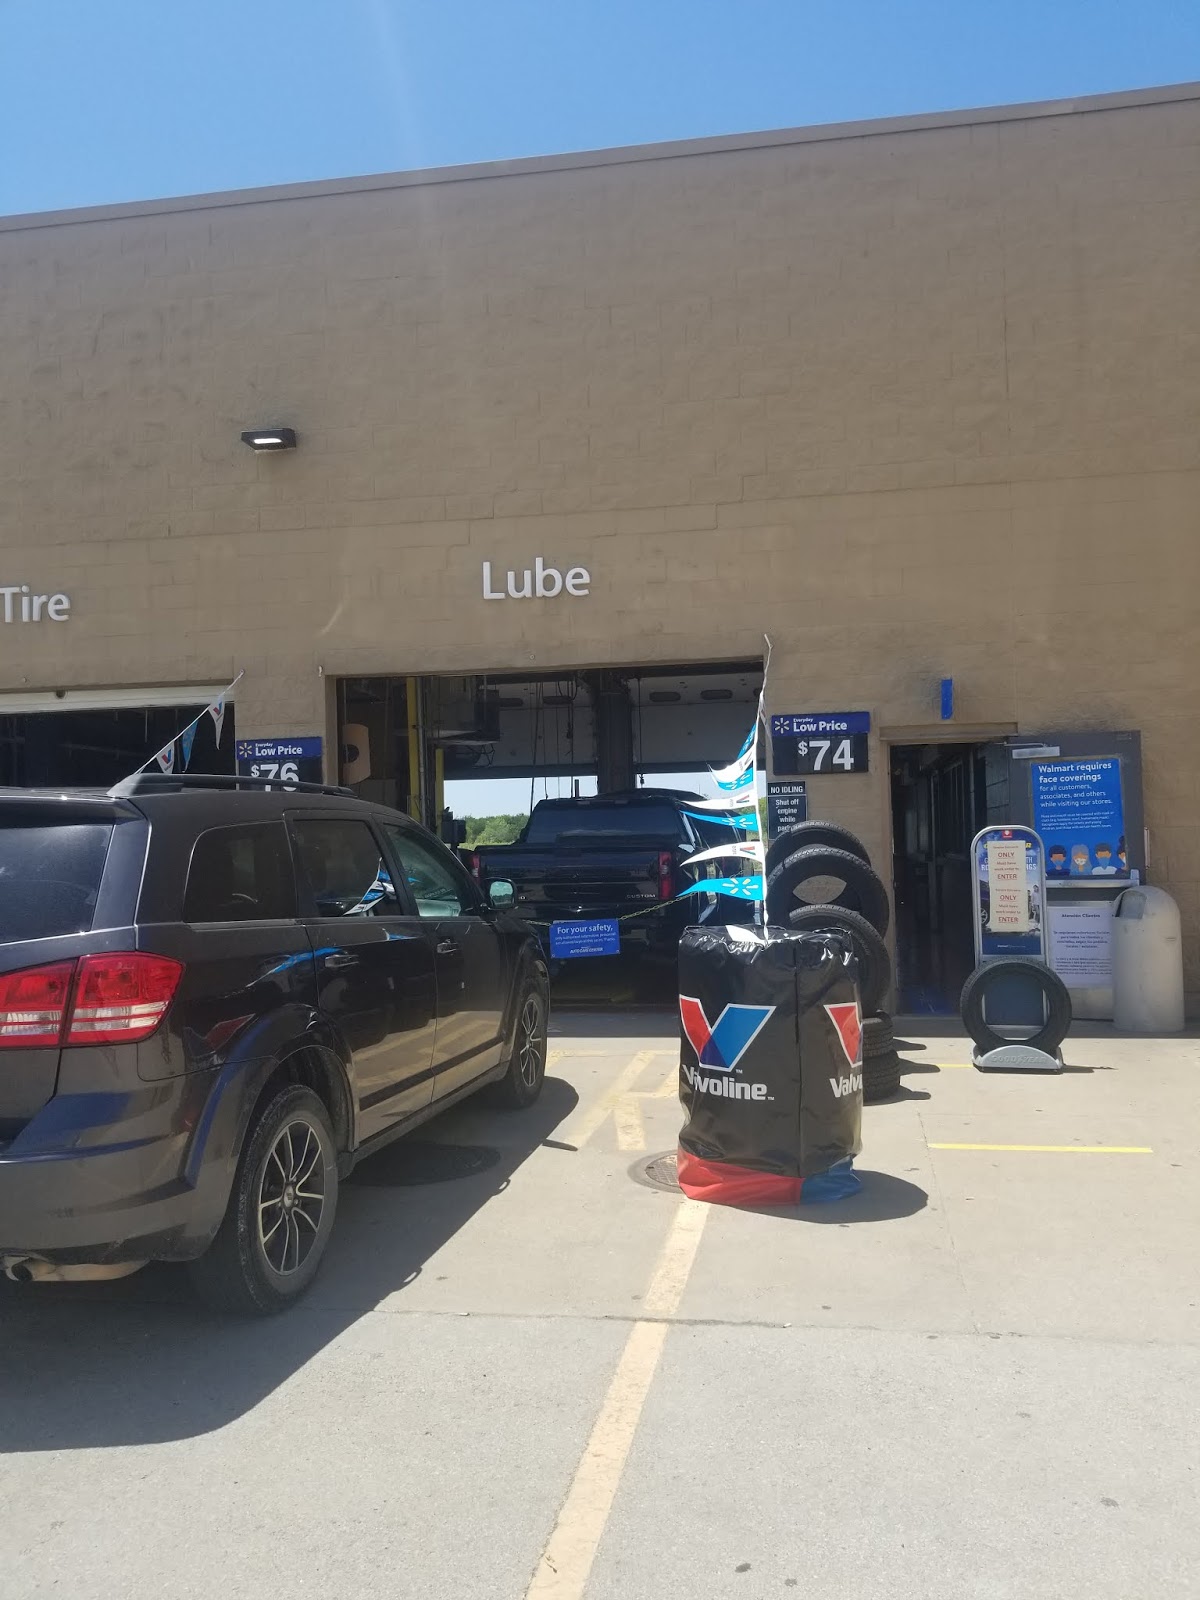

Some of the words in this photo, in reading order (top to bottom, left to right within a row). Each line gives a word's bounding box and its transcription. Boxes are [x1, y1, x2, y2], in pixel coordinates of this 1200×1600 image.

[482, 556, 591, 600] Lube
[0, 585, 71, 623] Tire
[793, 722, 817, 732] Low
[818, 720, 848, 731] Price
[255, 747, 276, 757] Low
[277, 745, 303, 755] Price
[797, 739, 855, 771] $74
[1038, 764, 1075, 773] Walmart
[1076, 761, 1112, 773] requires
[250, 762, 300, 792] $76
[1038, 775, 1058, 784] face
[1059, 772, 1102, 783] coverings
[770, 786, 780, 794] NO
[781, 785, 803, 793] IDLING
[1058, 783, 1092, 791] customers,
[1057, 799, 1079, 808] visiting
[777, 807, 798, 815] engine
[557, 926, 569, 934] For
[570, 926, 588, 935] your
[588, 923, 614, 932] safety,
[682, 1064, 768, 1101] Vvoline
